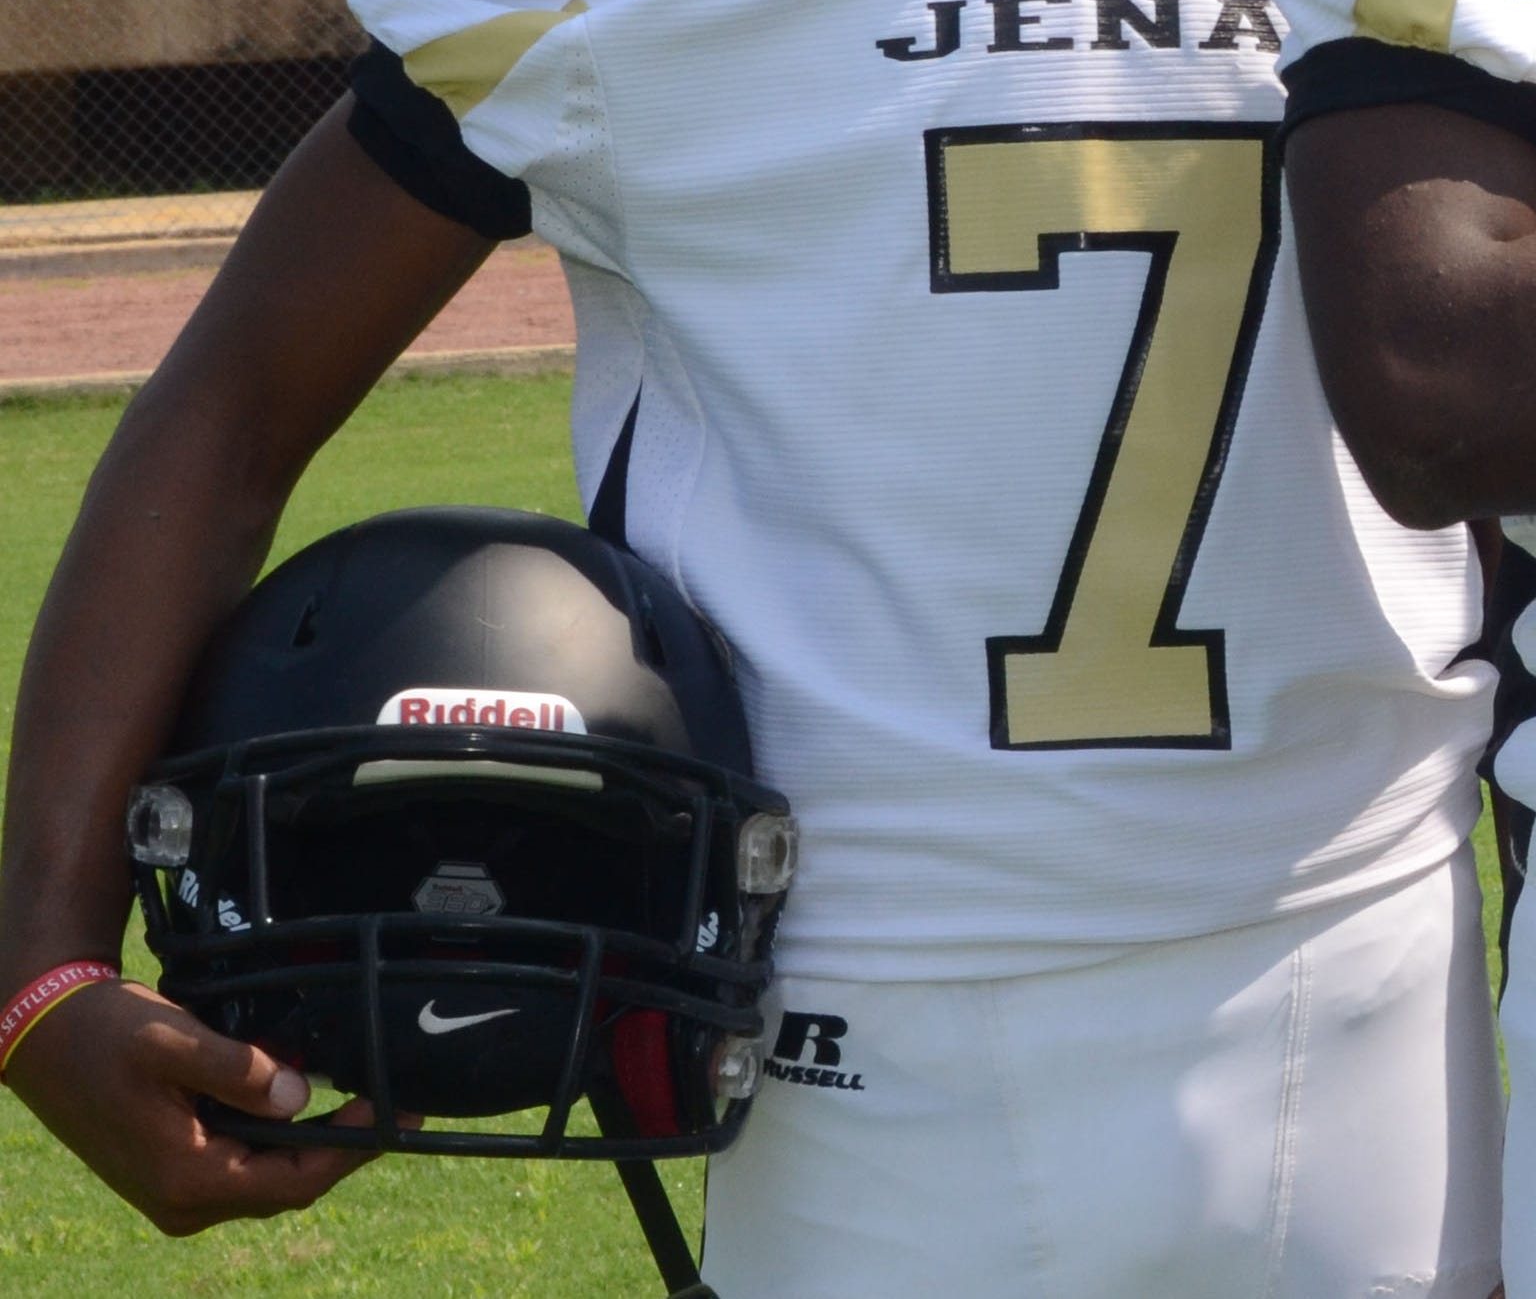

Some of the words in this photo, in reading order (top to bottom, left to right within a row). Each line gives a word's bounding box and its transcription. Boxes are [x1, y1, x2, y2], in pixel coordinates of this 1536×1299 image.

[924, 120, 1285, 750] 7
[401, 698, 564, 731] Riddell
[1, 978, 60, 1035] SETTLES
[60, 967, 86, 984] IT!
[773, 1010, 848, 1067] R
[763, 1058, 865, 1090] RUSSELL
